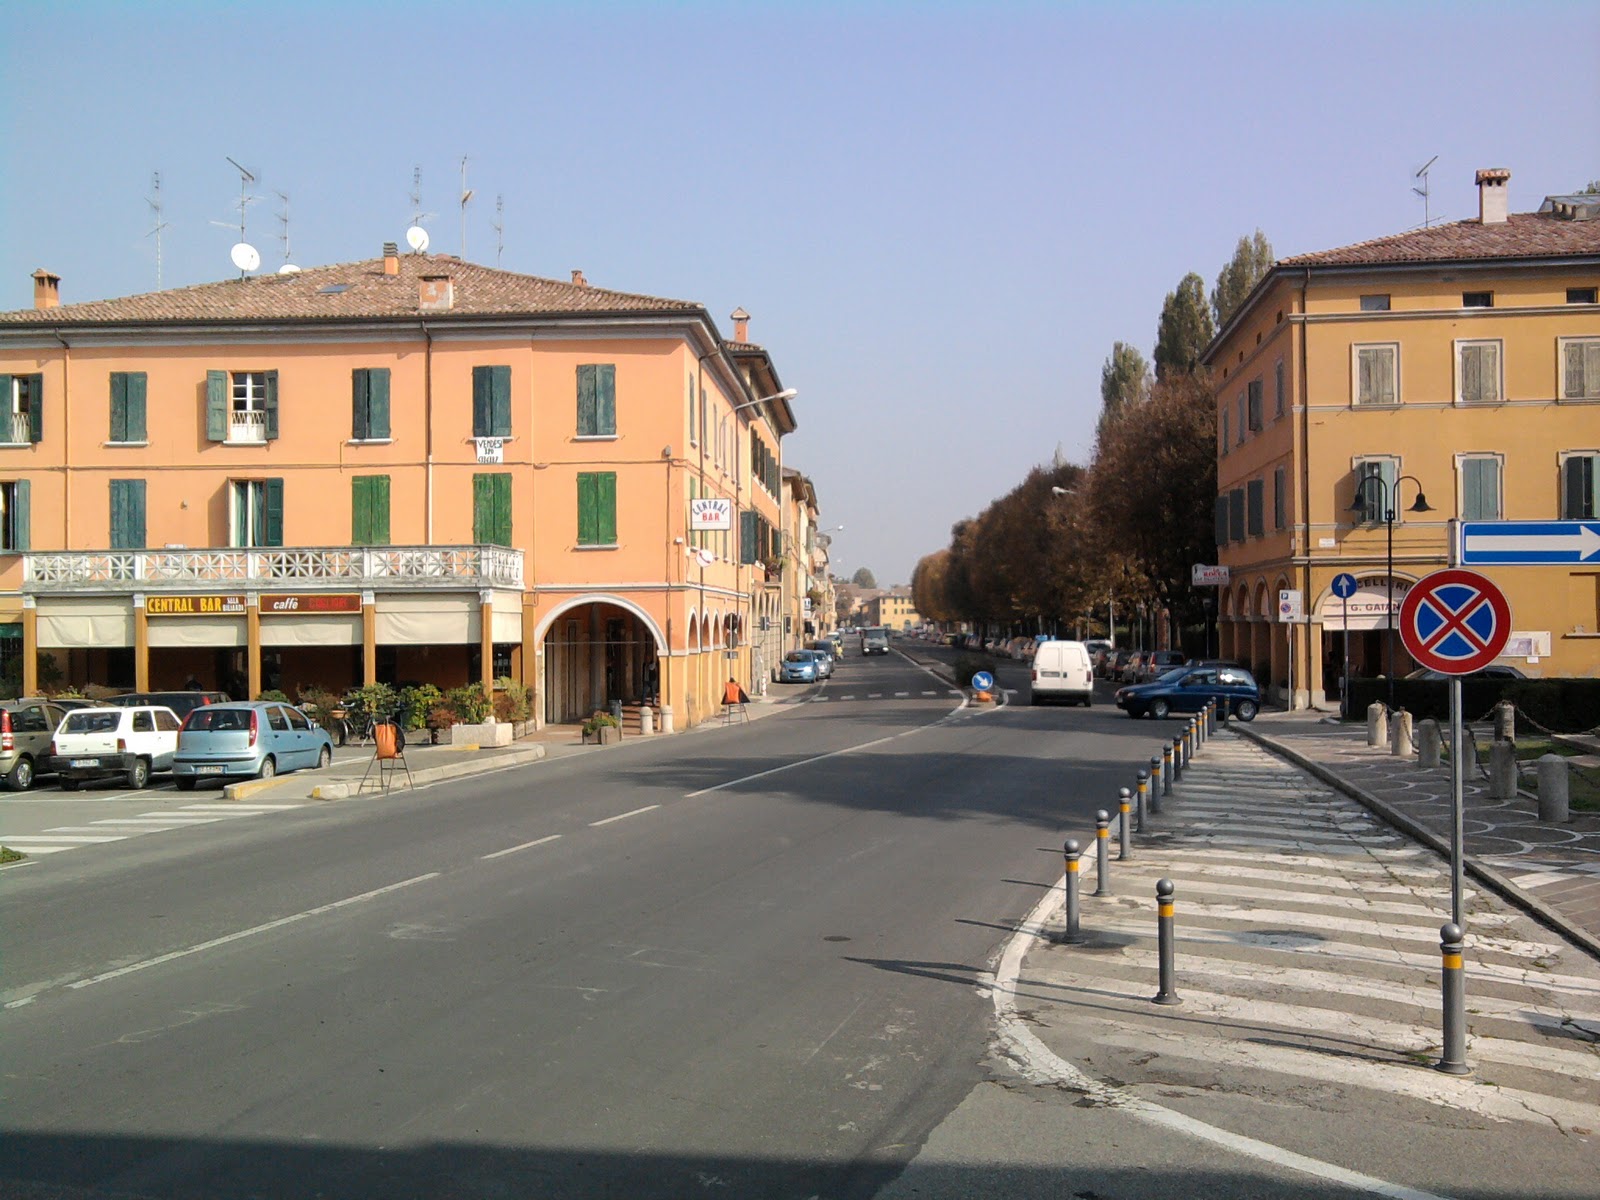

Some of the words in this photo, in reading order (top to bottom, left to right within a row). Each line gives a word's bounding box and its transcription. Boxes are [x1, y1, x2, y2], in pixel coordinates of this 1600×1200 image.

[692, 500, 728, 515] CENTRAL
[702, 512, 720, 521] BAR
[1357, 578, 1408, 592] CELLRI
[148, 597, 194, 612] CENTRAL
[200, 597, 221, 612] BAR
[273, 597, 298, 610] caffè
[1350, 603, 1362, 612] G.
[1365, 603, 1400, 611] GAIAN
